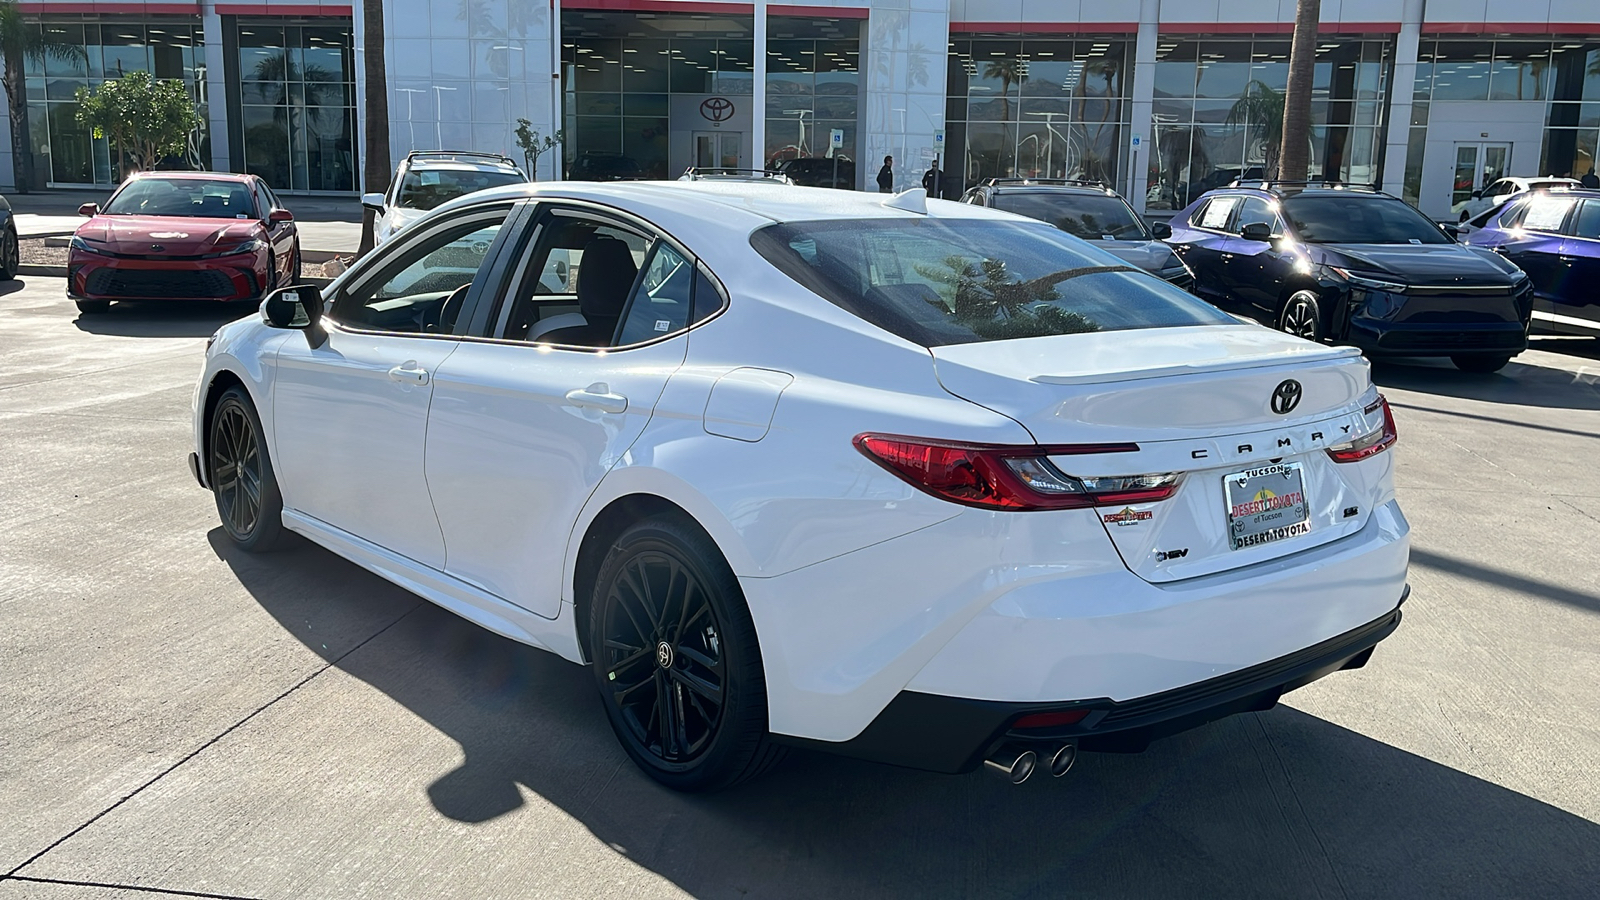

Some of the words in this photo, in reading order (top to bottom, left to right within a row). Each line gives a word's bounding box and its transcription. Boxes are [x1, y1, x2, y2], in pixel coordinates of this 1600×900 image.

[1191, 425, 1350, 459] CAMRY
[1245, 465, 1284, 477] TUCSON
[1232, 500, 1265, 518] DESERT
[1267, 492, 1302, 509] TOYOTA
[1261, 512, 1283, 522] Tucson
[1237, 532, 1270, 548] DESERT
[1273, 524, 1308, 540] TOYOTA
